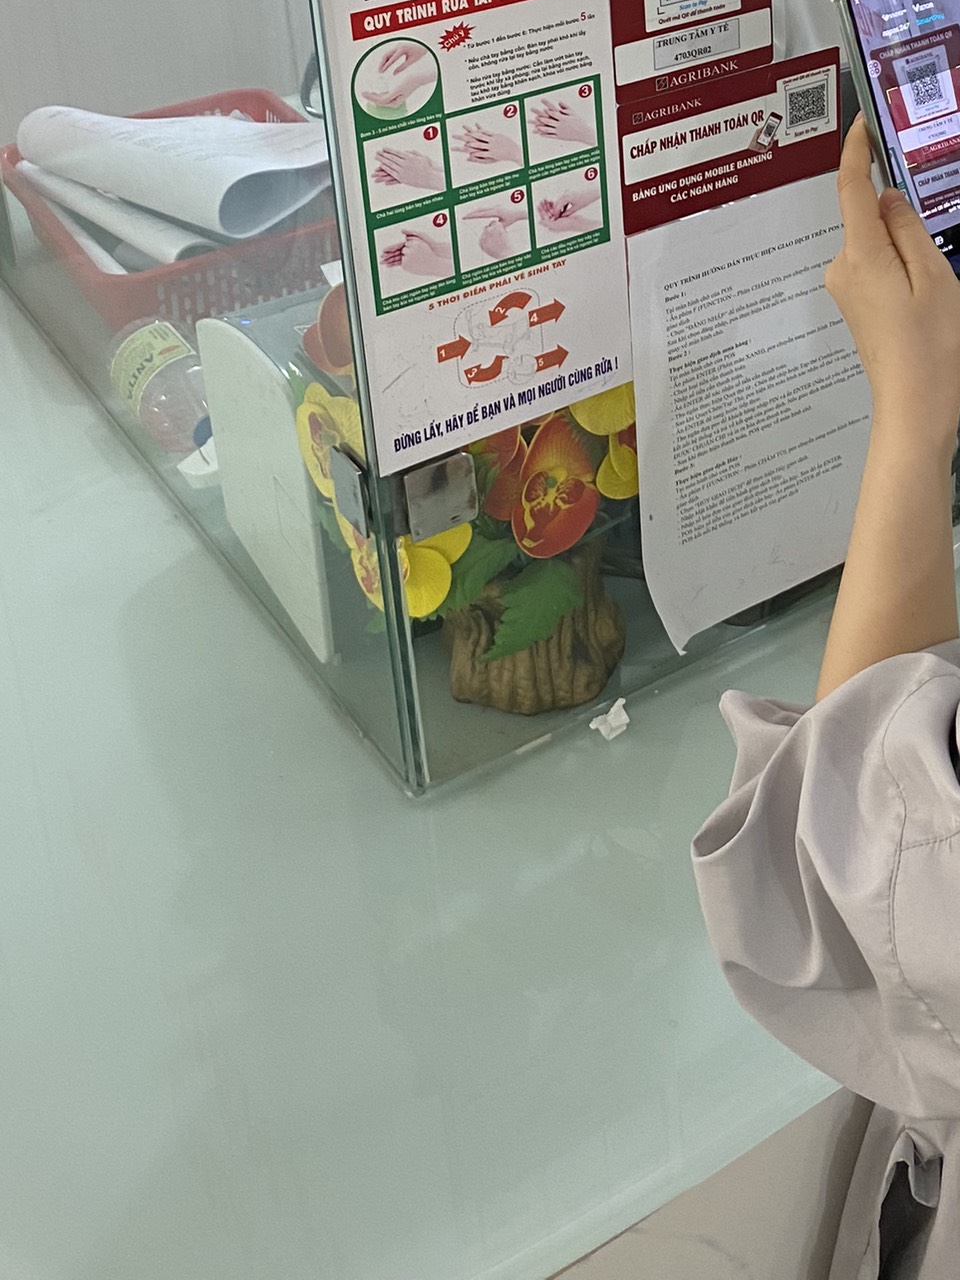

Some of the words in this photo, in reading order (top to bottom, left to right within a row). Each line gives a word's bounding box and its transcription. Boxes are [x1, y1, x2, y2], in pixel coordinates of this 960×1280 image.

[363, 12, 392, 32] QUY
[396, 0, 436, 25] TRÌNH
[656, 36, 687, 48] TRUNG
[674, 46, 711, 61] 4703QR02
[670, 61, 739, 87] AGRIBANK
[581, 85, 590, 97] 3
[506, 105, 516, 118] 2
[644, 98, 702, 121] AGRIBANK
[426, 128, 436, 139] 1
[630, 139, 656, 159] CHẤP
[659, 131, 687, 150] NHẬN
[689, 122, 721, 141] THANH
[724, 113, 749, 132] TOÁN
[752, 110, 764, 126] QR
[704, 163, 735, 181] MOBILE
[737, 151, 773, 169] BANKING
[586, 168, 595, 180] 6
[513, 190, 522, 202] 5
[436, 214, 445, 226] 4
[528, 266, 549, 277] SINH
[552, 259, 566, 268] TAY
[530, 313, 538, 322] 4
[440, 349, 445, 357] 1
[538, 358, 544, 366] 5
[468, 368, 478, 378] 3
[394, 430, 421, 452] ĐỪNG
[445, 411, 464, 433] HÃY
[482, 400, 501, 419] BẠN
[503, 392, 515, 411] VÀ
[518, 388, 536, 406] MỌI
[538, 376, 566, 398] NGƯỜI
[568, 366, 592, 387] CÙNG
[594, 357, 612, 377] RỬA
[615, 356, 618, 370] !
